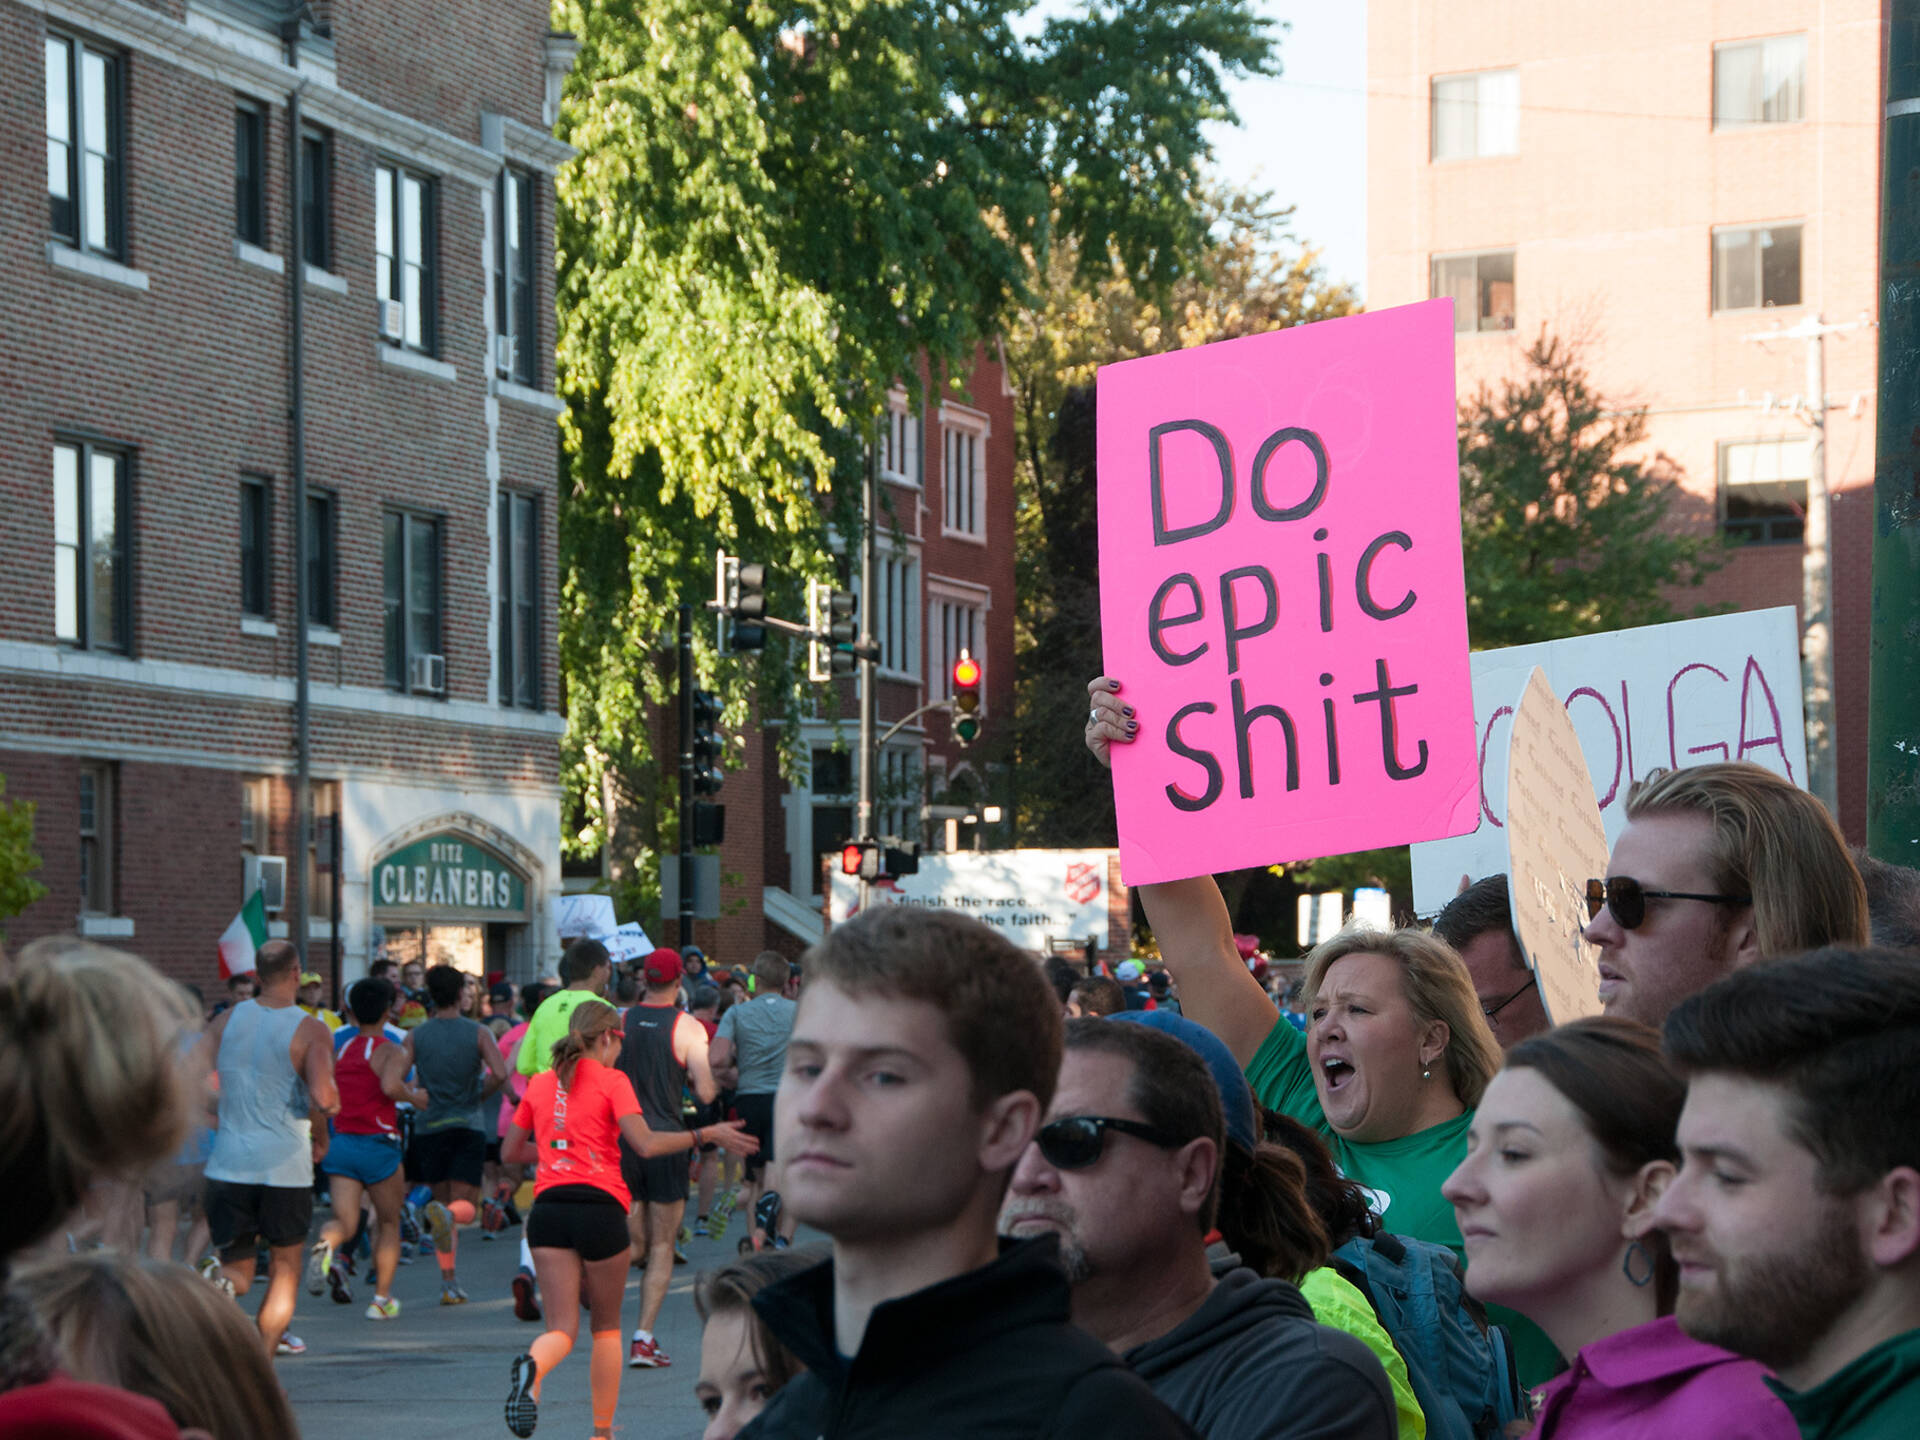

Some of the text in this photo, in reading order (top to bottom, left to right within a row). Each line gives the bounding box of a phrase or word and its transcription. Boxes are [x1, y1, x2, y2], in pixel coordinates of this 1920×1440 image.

[1148, 418, 1331, 546] Do
[1147, 527, 1418, 675] epic
[1164, 658, 1429, 813] shit
[379, 863, 511, 909] CLEANERS
[954, 894, 982, 907] the
